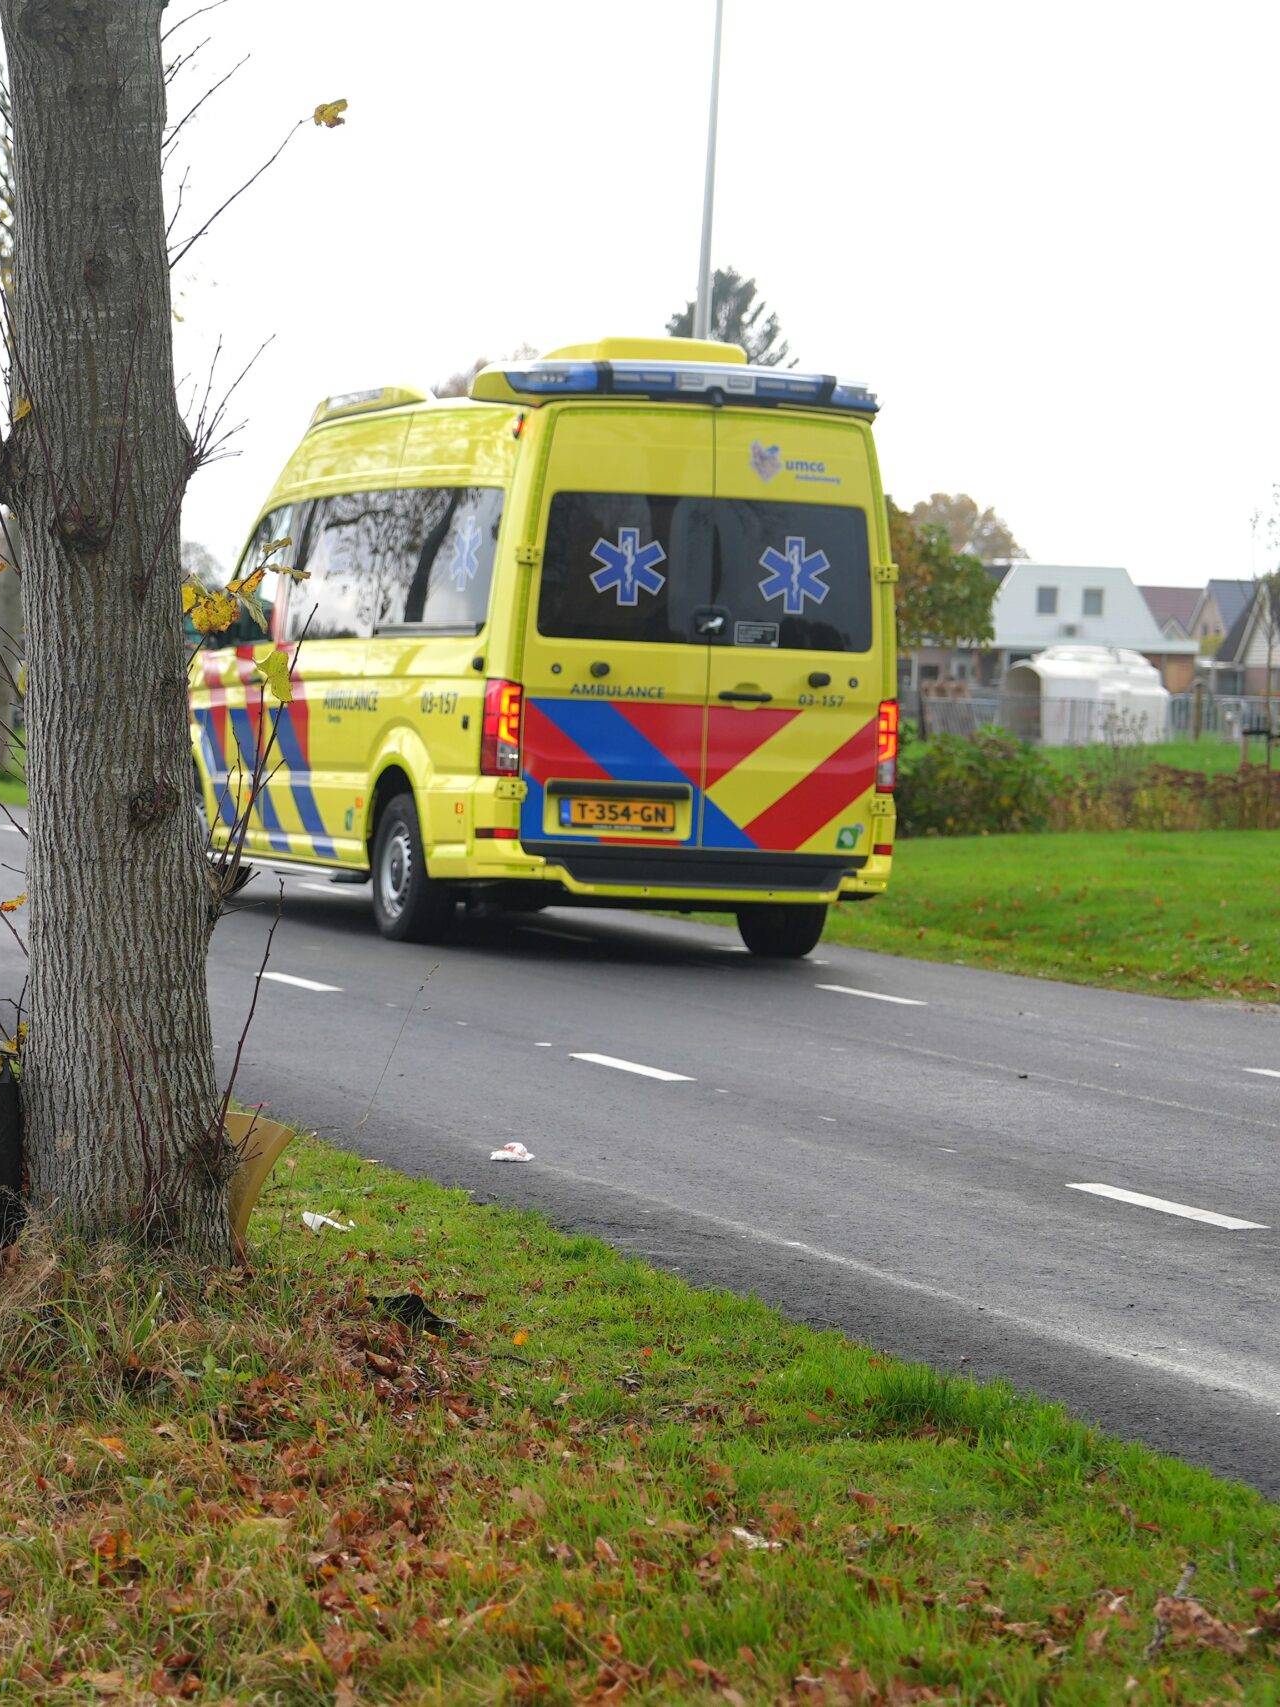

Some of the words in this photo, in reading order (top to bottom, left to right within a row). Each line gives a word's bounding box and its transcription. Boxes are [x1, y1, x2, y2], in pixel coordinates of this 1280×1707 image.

[323, 690, 379, 712] AMBULANCE
[570, 684, 666, 699] AMBULANCE
[799, 694, 845, 707] 03-157
[421, 691, 458, 714] 03-157
[577, 802, 667, 823] T-354-GN
